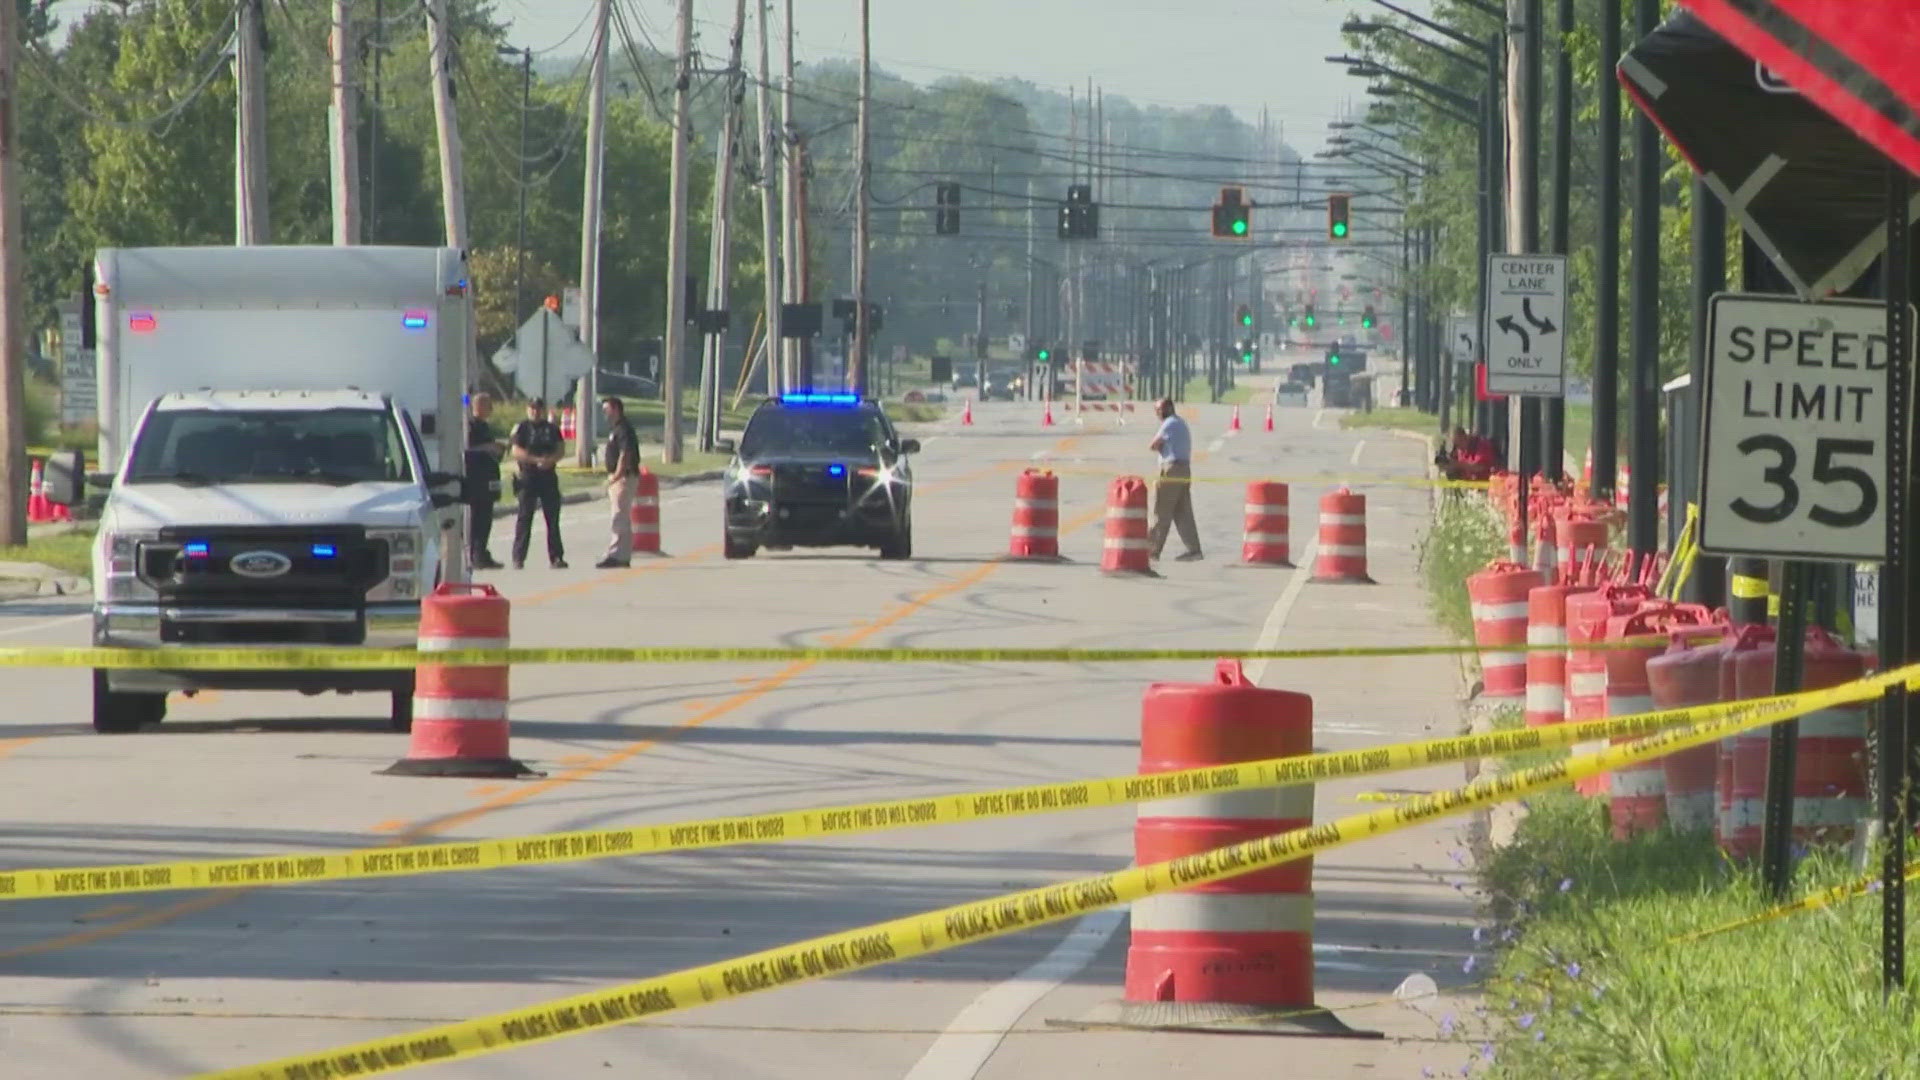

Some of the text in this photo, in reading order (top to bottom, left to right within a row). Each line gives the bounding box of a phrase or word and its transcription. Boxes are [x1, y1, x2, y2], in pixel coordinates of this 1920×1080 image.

[1501, 262, 1555, 275] CENTER
[1508, 277, 1546, 290] LANE
[1507, 356, 1543, 369] ONLY
[1727, 326, 1888, 371] SPEED
[1743, 379, 1873, 423] LIMIT
[1728, 434, 1878, 529] 35
[945, 876, 1118, 941] POLICE LINE DO NOT CROSS
[722, 932, 897, 995] POLICE LINE DO NOT CROSS
